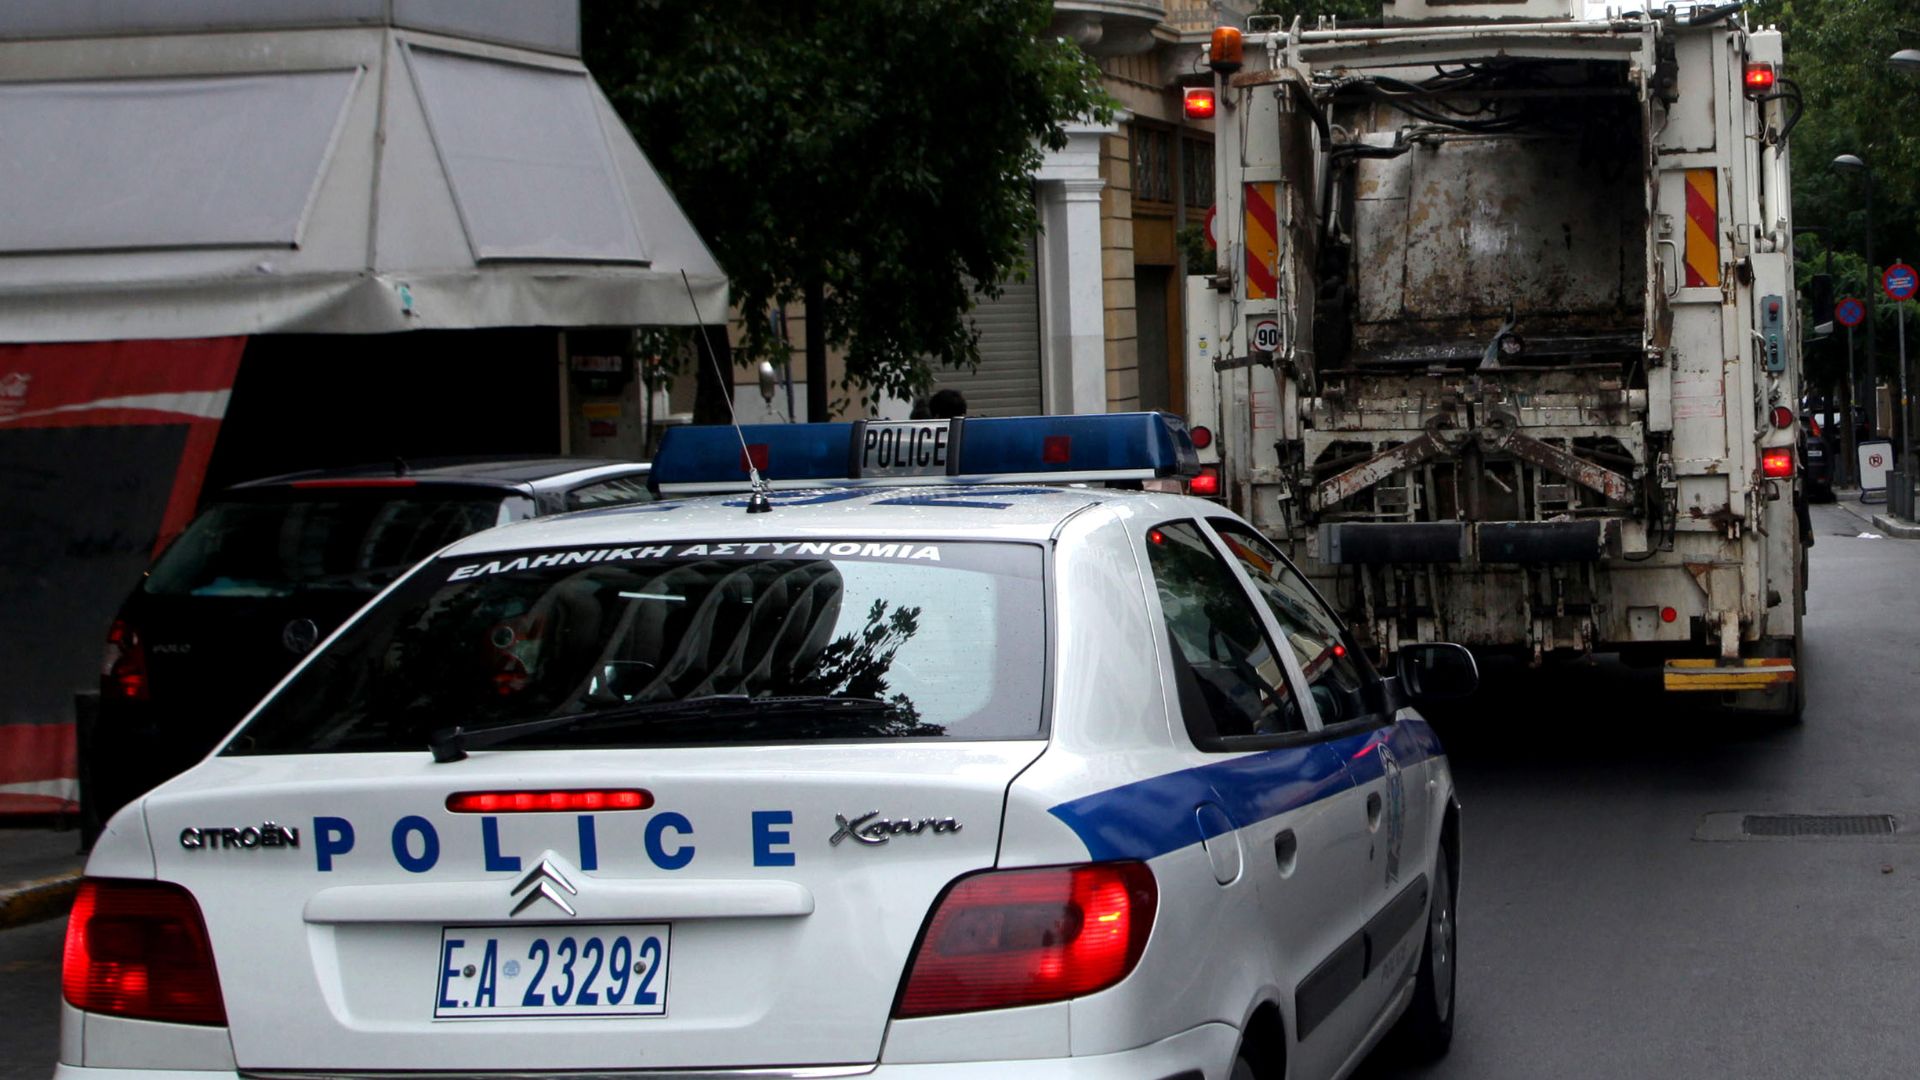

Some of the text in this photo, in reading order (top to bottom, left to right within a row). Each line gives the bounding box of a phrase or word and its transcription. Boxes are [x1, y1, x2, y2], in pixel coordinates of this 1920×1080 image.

[1258, 329, 1278, 346] 90
[863, 427, 948, 468] POLICE
[447, 541, 941, 582] ΕΛΛΗΝΙΚΗ ΑΣΤΥΝΟΜΙΑ
[179, 821, 299, 849] CITROËN
[313, 810, 796, 873] POLICE
[522, 935, 662, 1007] 23292
